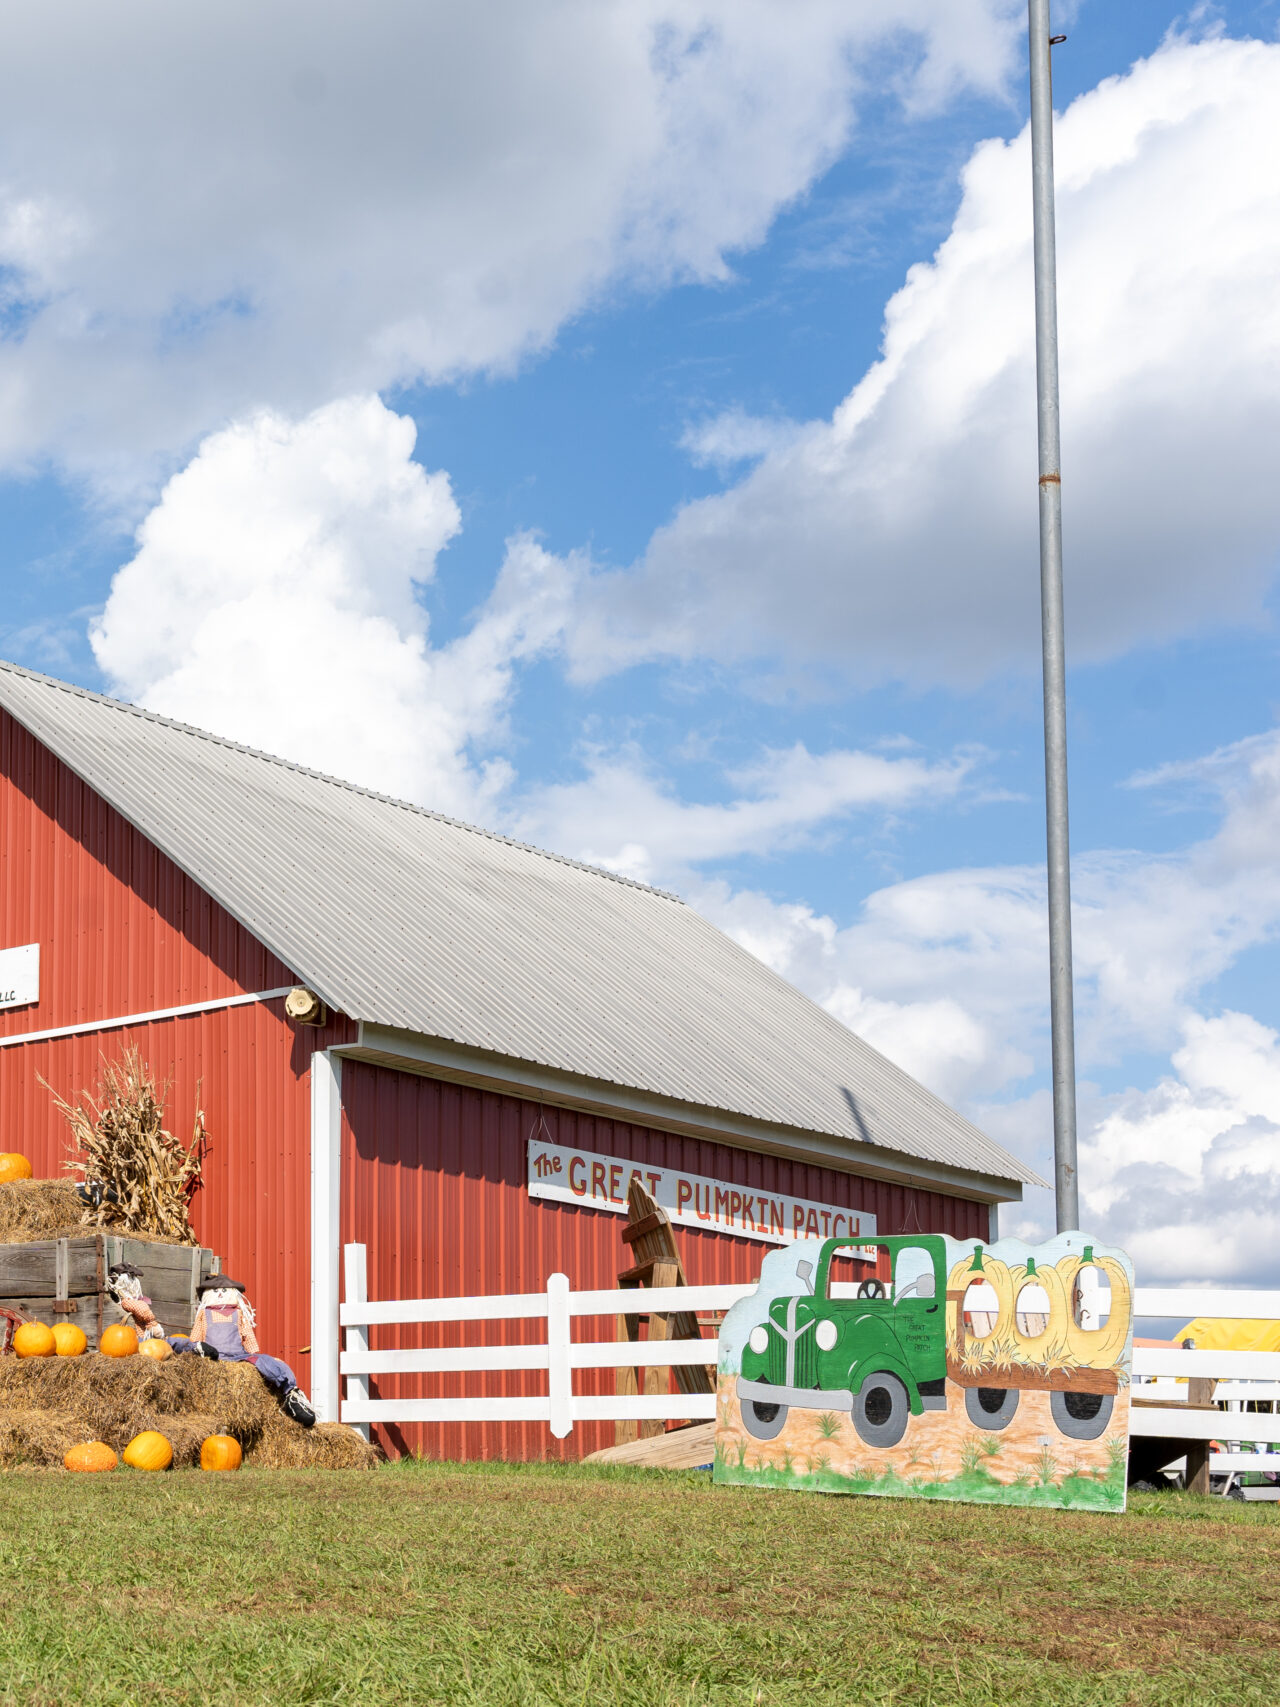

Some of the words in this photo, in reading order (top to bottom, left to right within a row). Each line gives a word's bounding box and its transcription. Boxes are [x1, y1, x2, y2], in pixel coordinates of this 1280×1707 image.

[533, 1153, 563, 1178] The
[676, 1178, 785, 1237] PUMPKIN
[792, 1204, 860, 1251] PATCH
